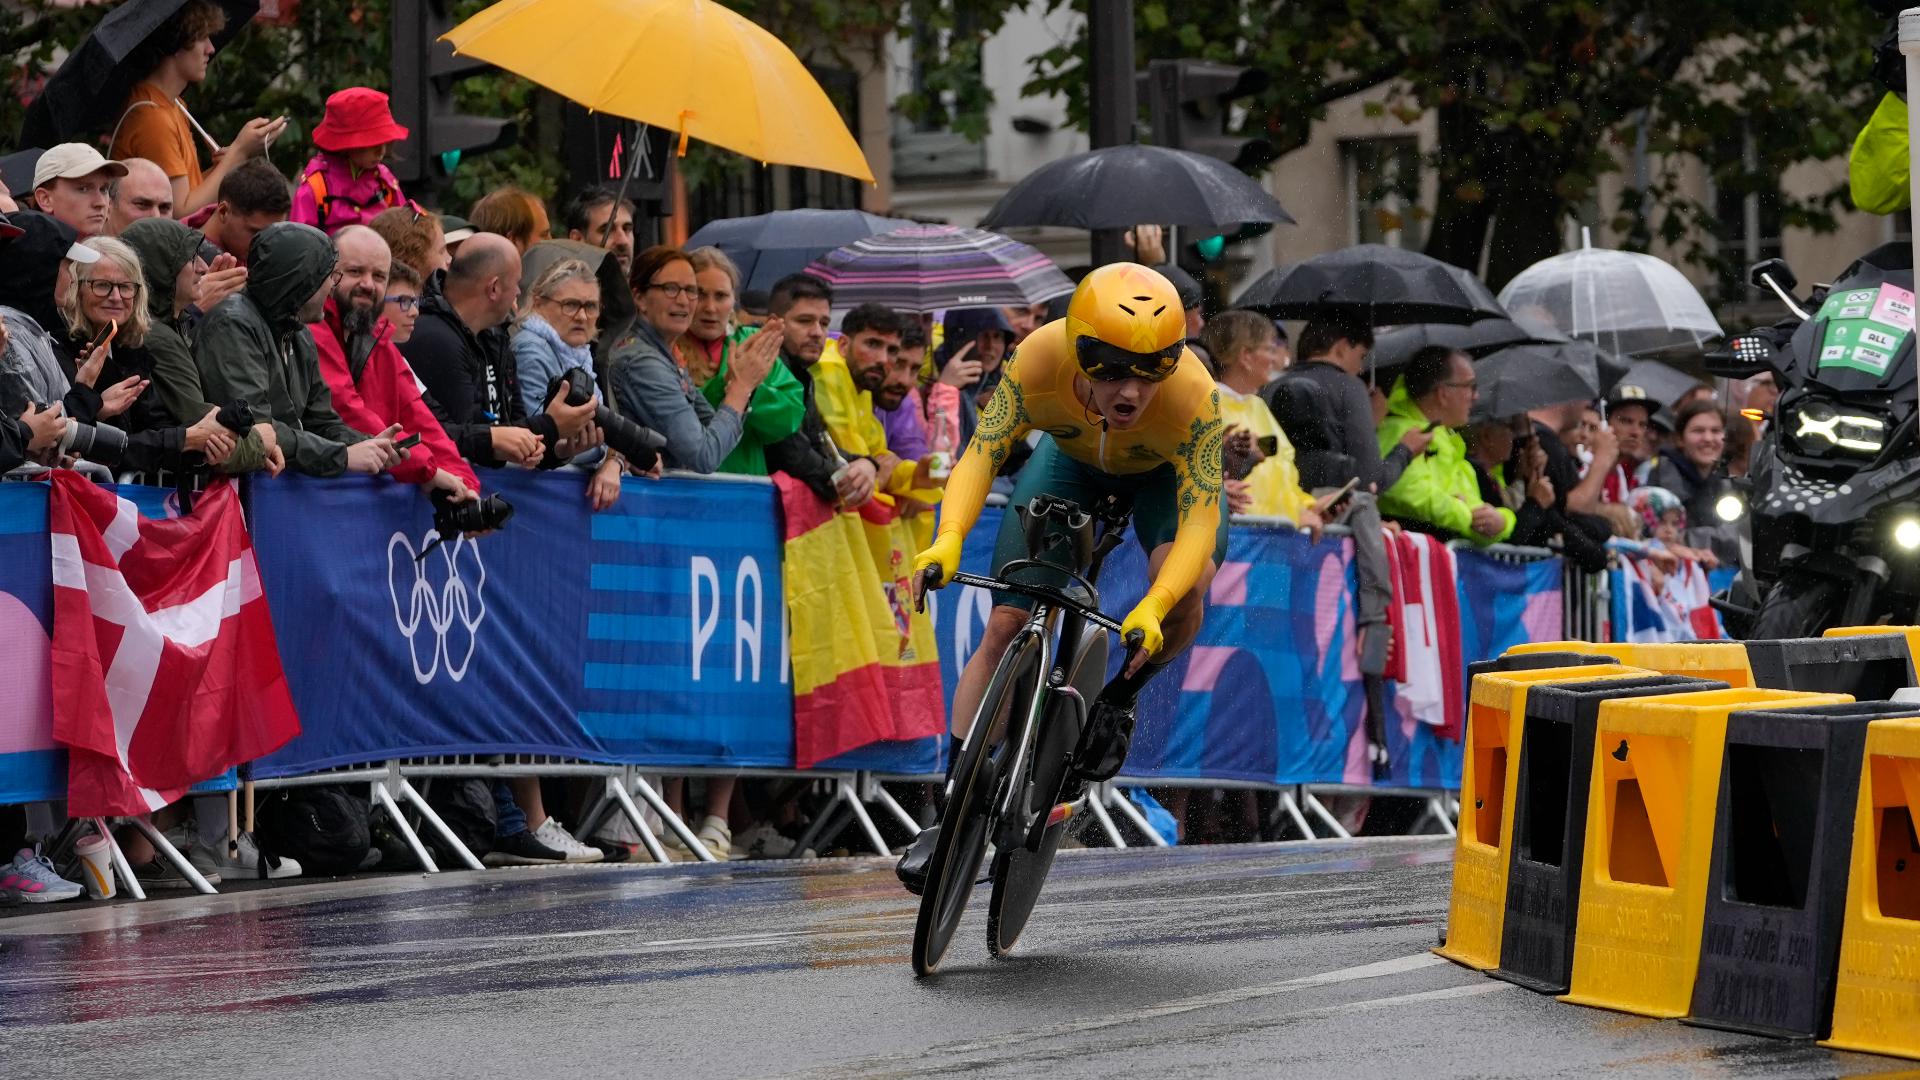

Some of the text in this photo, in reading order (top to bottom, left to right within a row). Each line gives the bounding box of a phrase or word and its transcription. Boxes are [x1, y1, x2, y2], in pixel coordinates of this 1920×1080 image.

[1867, 333, 1887, 345] ALL
[953, 575, 1011, 589] LAPIERRE
[691, 555, 788, 683] PA
[1079, 608, 1122, 631] LAPIERR
